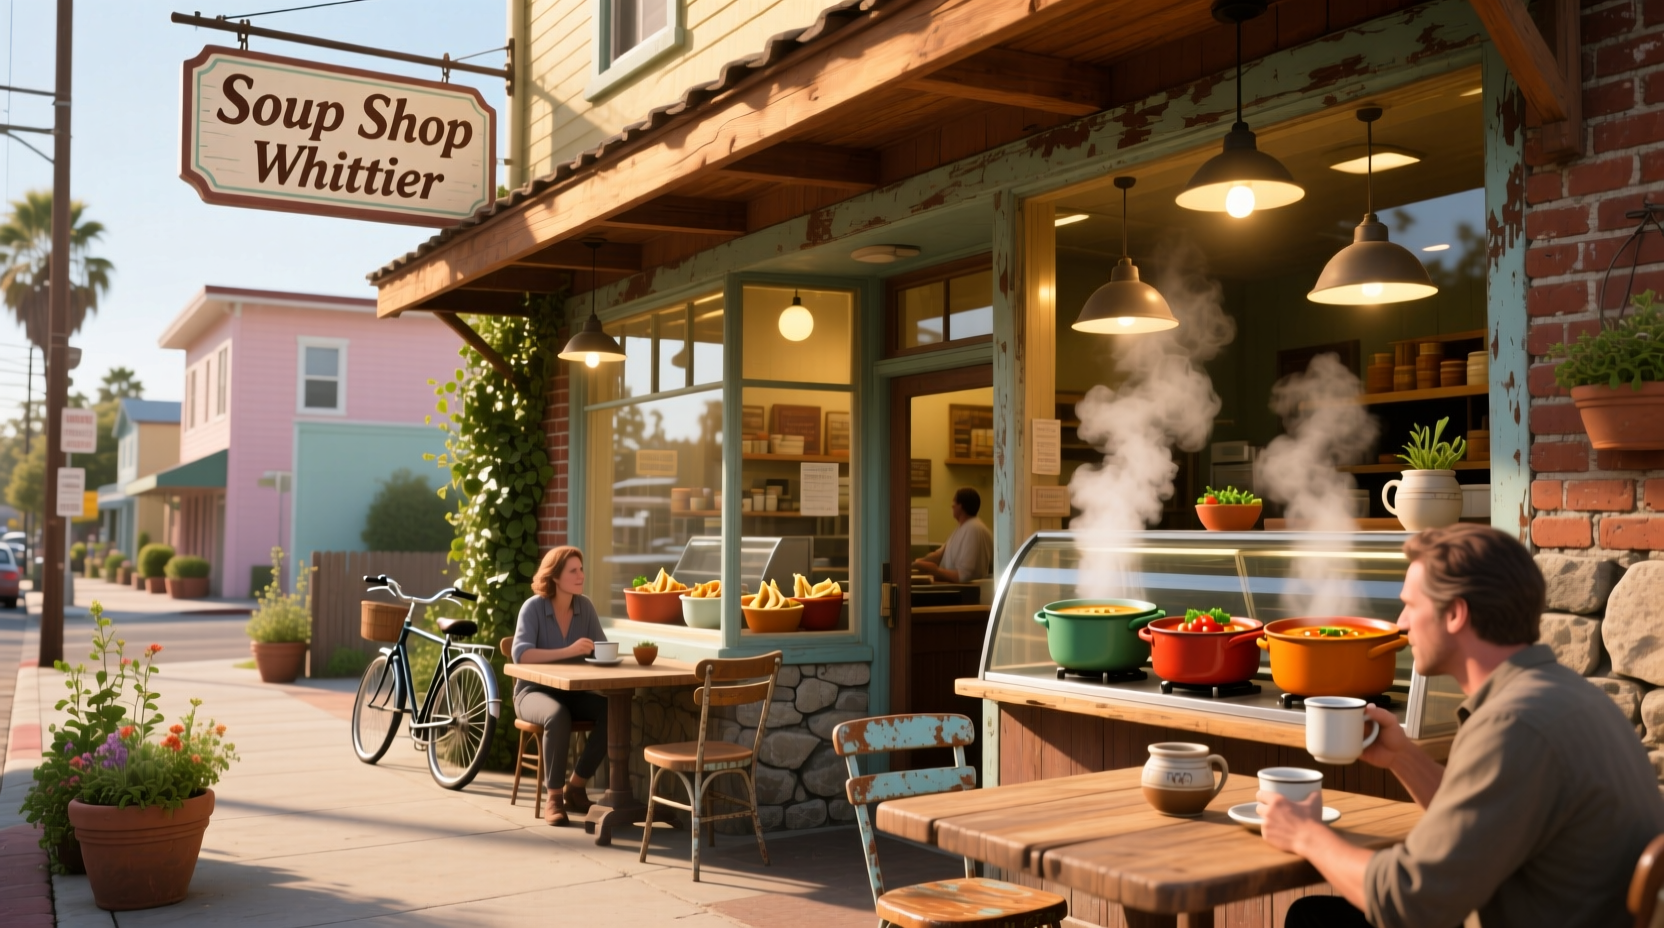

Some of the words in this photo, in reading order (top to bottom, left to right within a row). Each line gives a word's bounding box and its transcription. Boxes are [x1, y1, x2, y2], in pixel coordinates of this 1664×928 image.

[216, 73, 345, 141] Soup
[357, 93, 473, 159] Shop
[254, 140, 445, 200] Whittier
